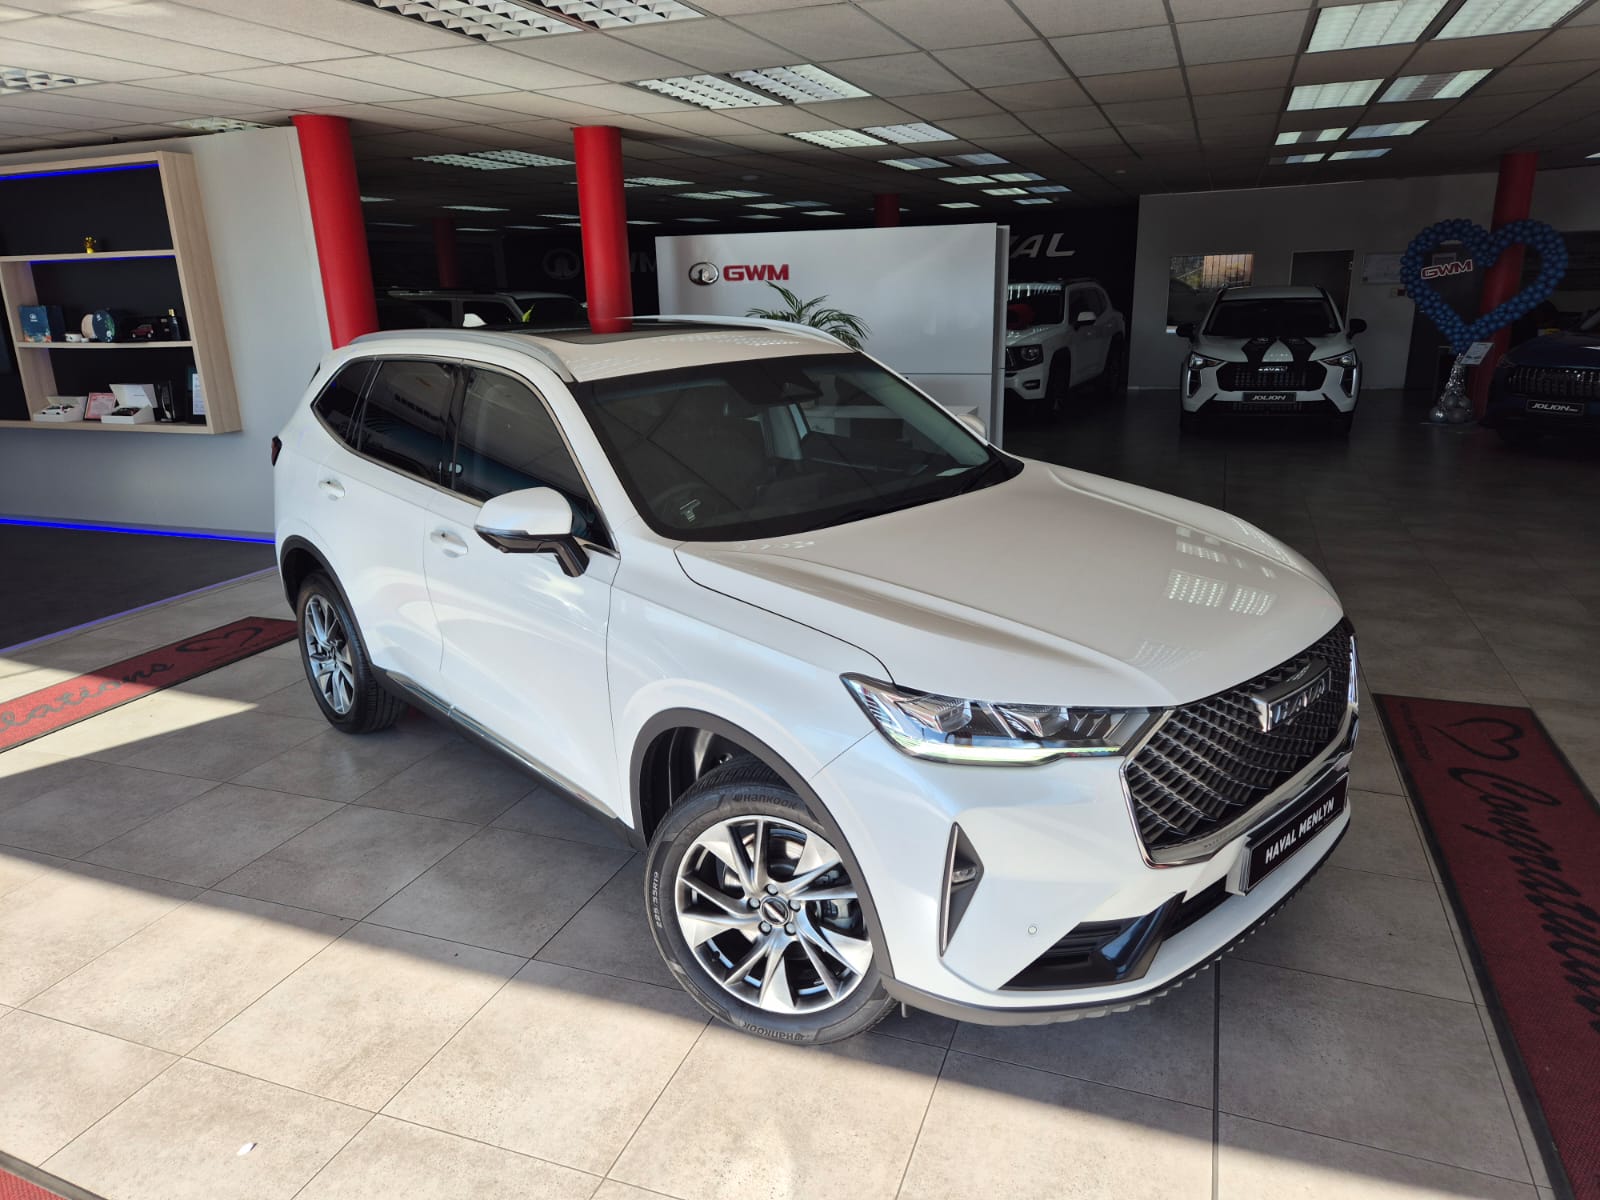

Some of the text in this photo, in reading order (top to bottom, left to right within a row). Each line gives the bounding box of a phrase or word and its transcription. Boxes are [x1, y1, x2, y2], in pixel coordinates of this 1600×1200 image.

[723, 264, 789, 282] GWM
[1421, 259, 1473, 280] GWM
[1531, 402, 1570, 412] JOLION
[1265, 828, 1297, 864] HAVAL
[1298, 796, 1335, 839] MENLYN
